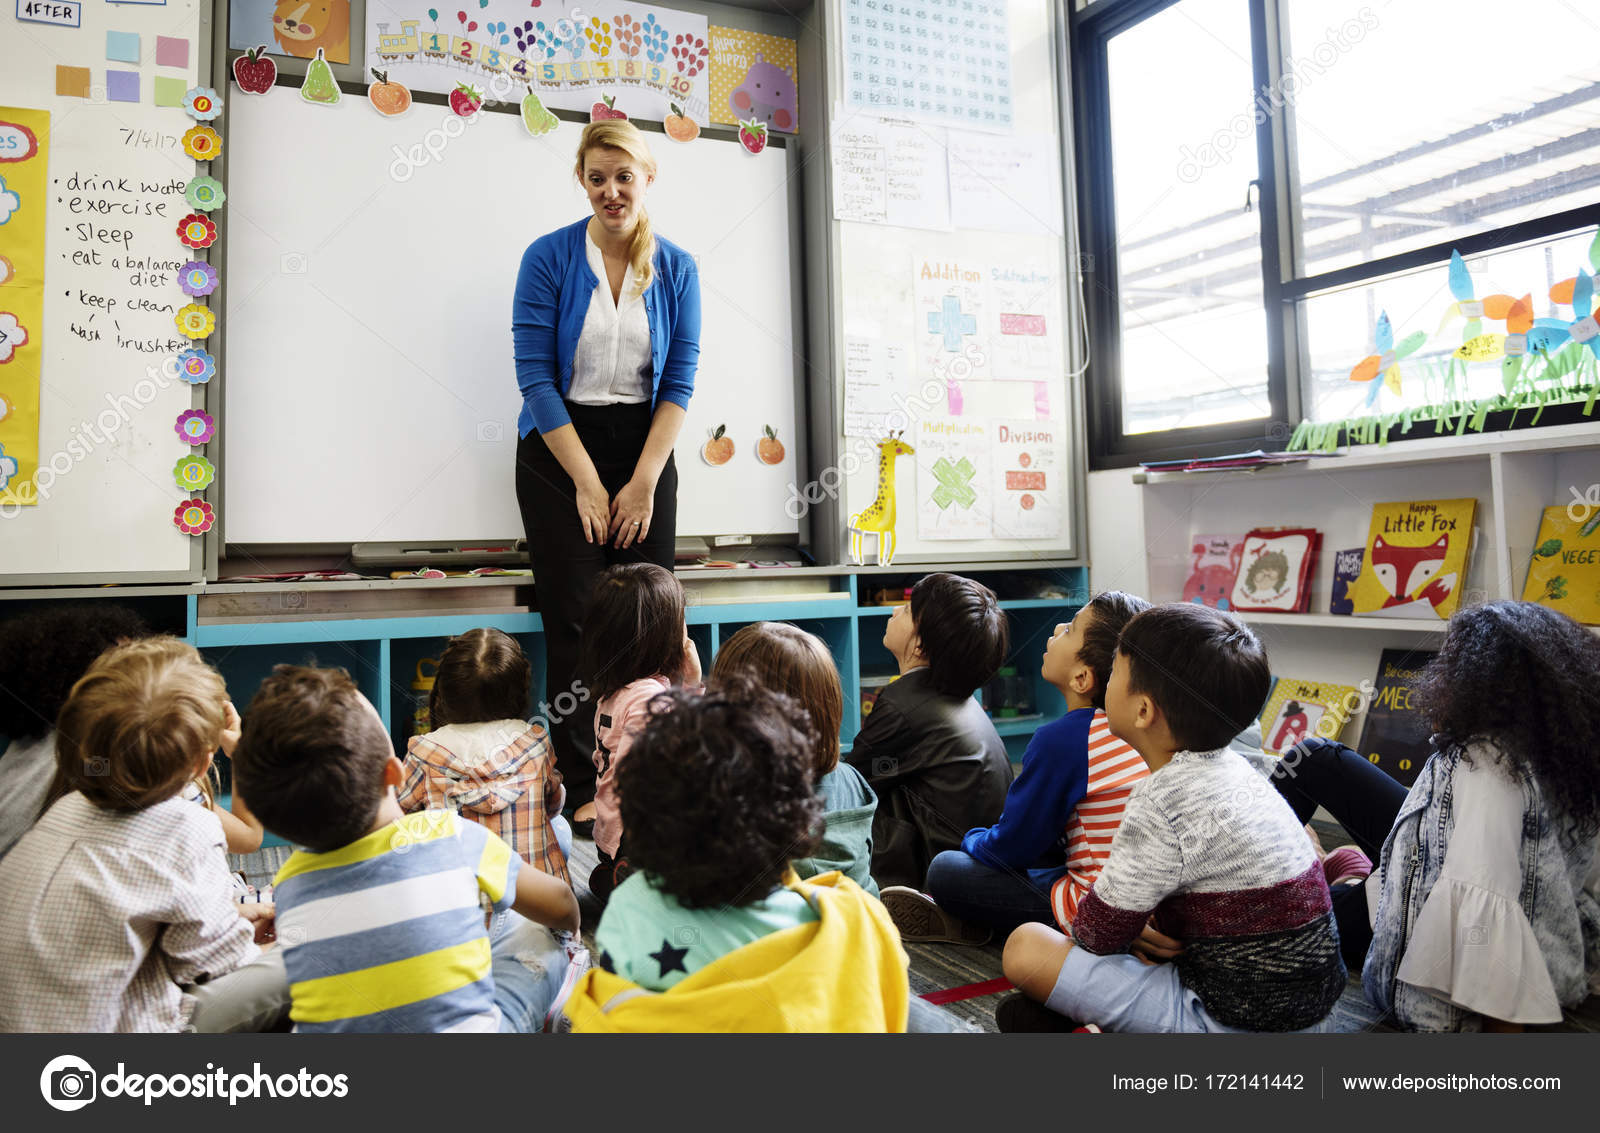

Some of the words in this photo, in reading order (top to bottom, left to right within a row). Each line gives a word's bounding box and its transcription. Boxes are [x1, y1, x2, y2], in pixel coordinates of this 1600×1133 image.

[25, 2, 73, 19] AFTER
[430, 35, 440, 51] 1
[461, 42, 472, 58] 2
[488, 50, 500, 66] 3
[513, 59, 527, 76] 4
[543, 64, 555, 80] 5
[596, 62, 611, 77] 7
[626, 61, 635, 76] 8
[651, 67, 661, 81] 9
[672, 75, 690, 93] 10
[198, 98, 207, 110] 0
[120, 128, 177, 148] 7/4/17
[198, 138, 206, 150] 1
[67, 172, 133, 192] drink
[141, 180, 188, 195] wate
[69, 197, 167, 218] exercise
[191, 225, 202, 239] 3
[72, 249, 102, 266] eat
[112, 258, 120, 270] a
[126, 255, 188, 272] balance
[130, 272, 169, 288] diet
[192, 271, 203, 285] 4
[920, 261, 981, 283] Addition
[127, 298, 175, 315] clean
[191, 316, 201, 329] 5
[189, 360, 200, 375] 6
[189, 420, 201, 434] 7
[999, 425, 1053, 444] Division
[189, 465, 199, 481] 8
[189, 510, 200, 524] 9
[1409, 503, 1437, 515] Happy
[1384, 515, 1425, 534] Little
[1432, 514, 1457, 532] Fox
